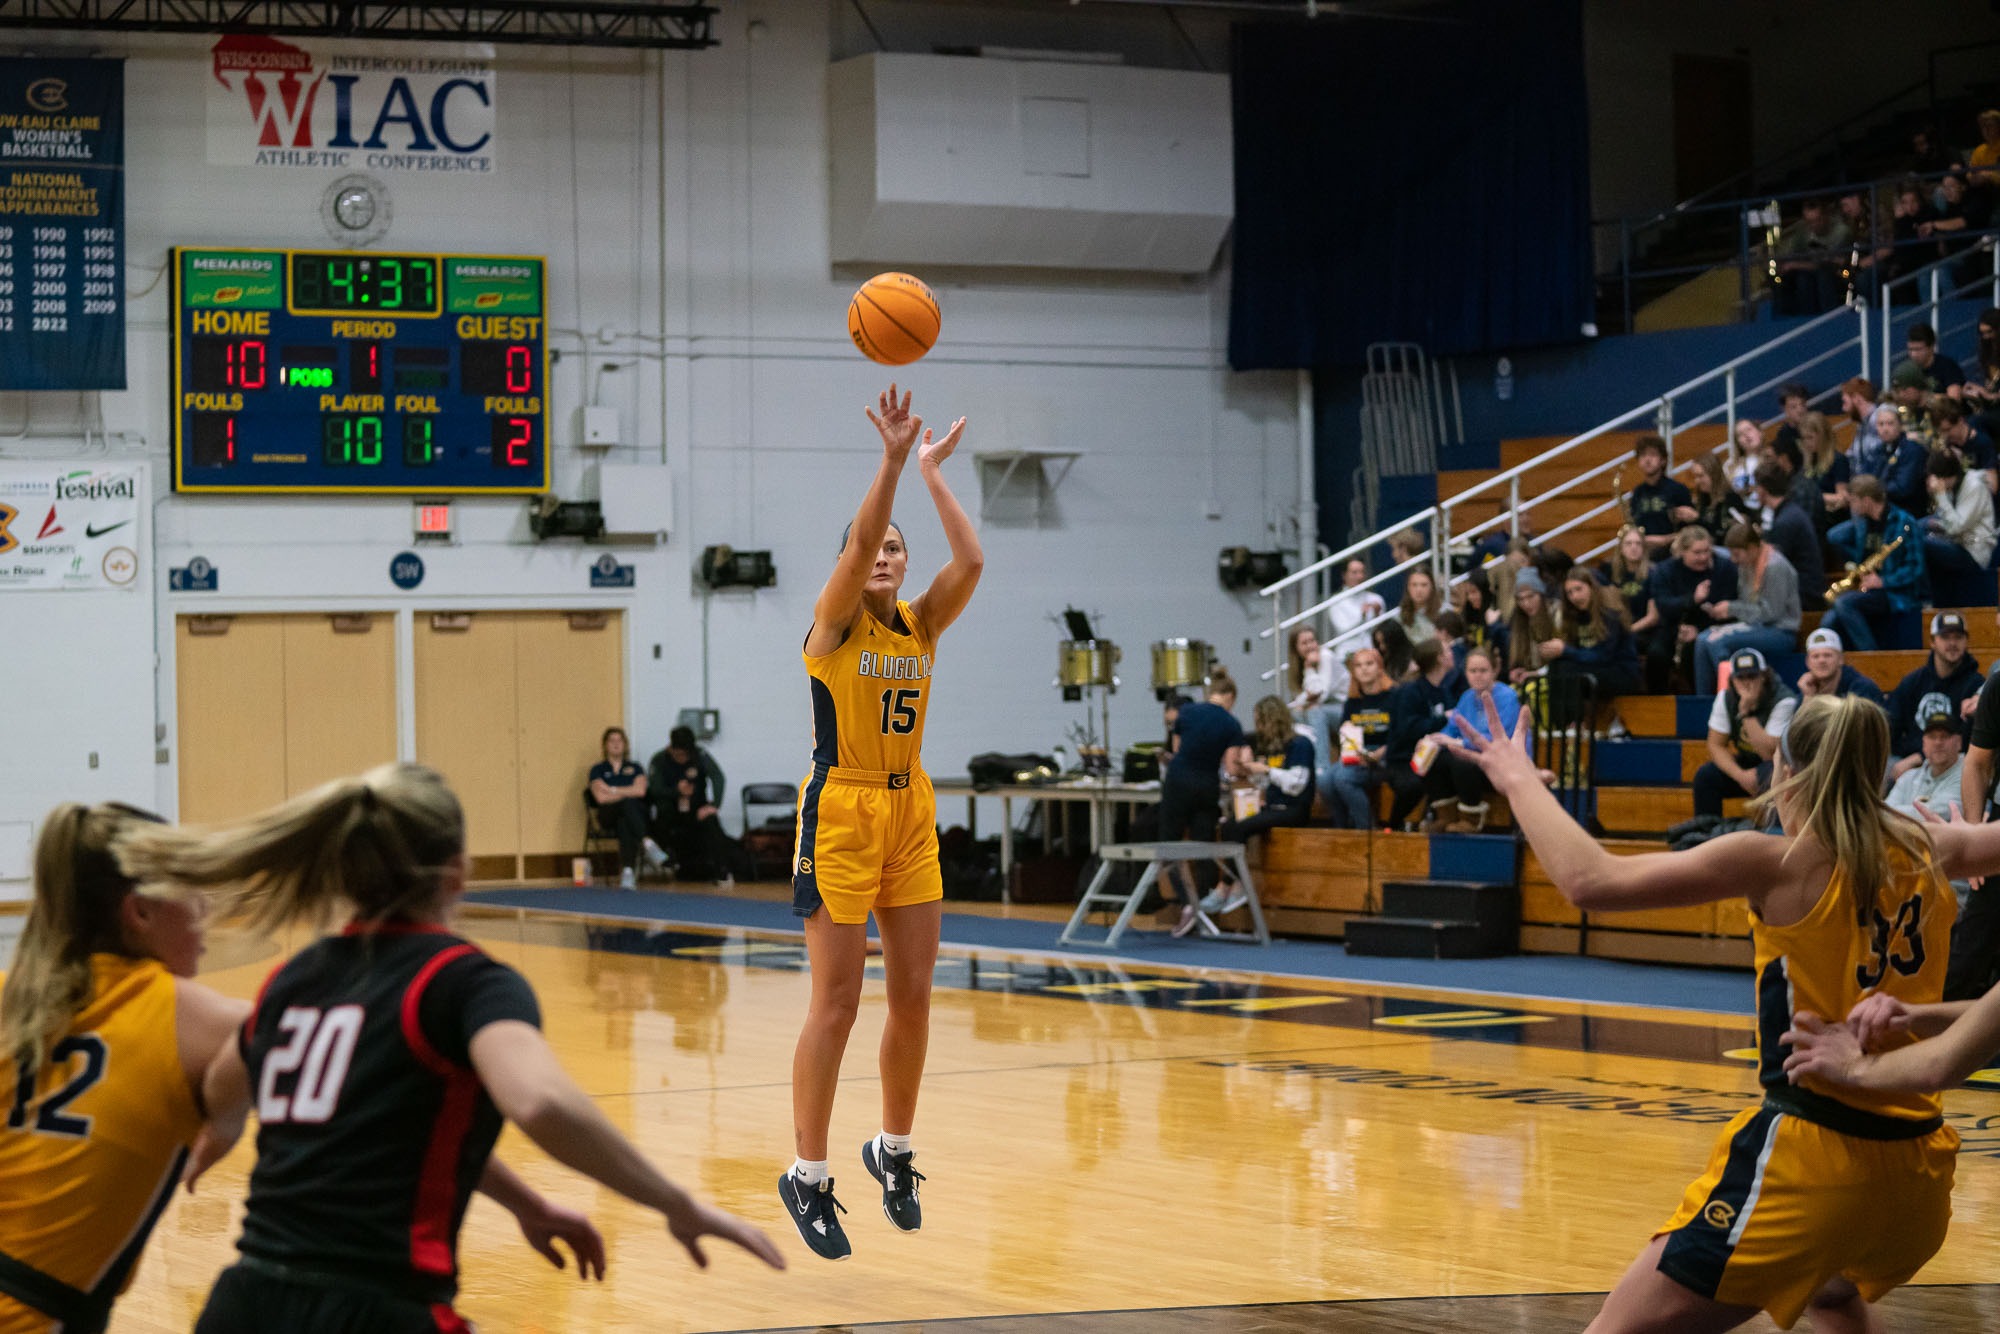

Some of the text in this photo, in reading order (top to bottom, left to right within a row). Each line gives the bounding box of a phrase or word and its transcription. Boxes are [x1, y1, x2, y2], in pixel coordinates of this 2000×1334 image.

[332, 55, 488, 75] INTERCOLLEGIATE
[53, 115, 100, 130] CLAIRE
[13, 129, 82, 144] WOMEN'S
[2, 142, 93, 158] BASKETBALL
[256, 151, 491, 171] ATHLETIC CONFERENCE
[11, 172, 84, 188] NATIONAL
[32, 227, 67, 241] 1990
[83, 228, 116, 242] 1992
[32, 245, 67, 259] 1994
[83, 246, 116, 260] 1995
[32, 263, 67, 278] 1997
[83, 264, 116, 279] 1998
[193, 258, 273, 271] MENARDS
[455, 265, 532, 277] MENARDS
[32, 281, 67, 296] 2000
[83, 282, 116, 297] 2001
[327, 260, 433, 308] 4:37
[32, 299, 67, 314] 2008
[83, 300, 116, 315] 2009
[32, 317, 67, 331] 2022
[192, 310, 270, 336] HOME
[331, 320, 397, 339] PERIOD
[455, 315, 542, 340] GUEST
[226, 341, 266, 389] 10
[369, 345, 377, 378] 1
[506, 345, 532, 393] 0
[184, 392, 244, 411] FOULS
[319, 394, 441, 413] PLAYER FOUL
[484, 396, 541, 414] FOULS
[226, 417, 235, 461] 1
[343, 416, 383, 465] 10
[423, 419, 432, 463] 1
[506, 418, 532, 466] 2
[56, 476, 135, 500] festival
[880, 687, 921, 736] 15
[1856, 893, 1926, 990] 33
[256, 1003, 366, 1125] 20
[8, 1031, 111, 1140] 12
